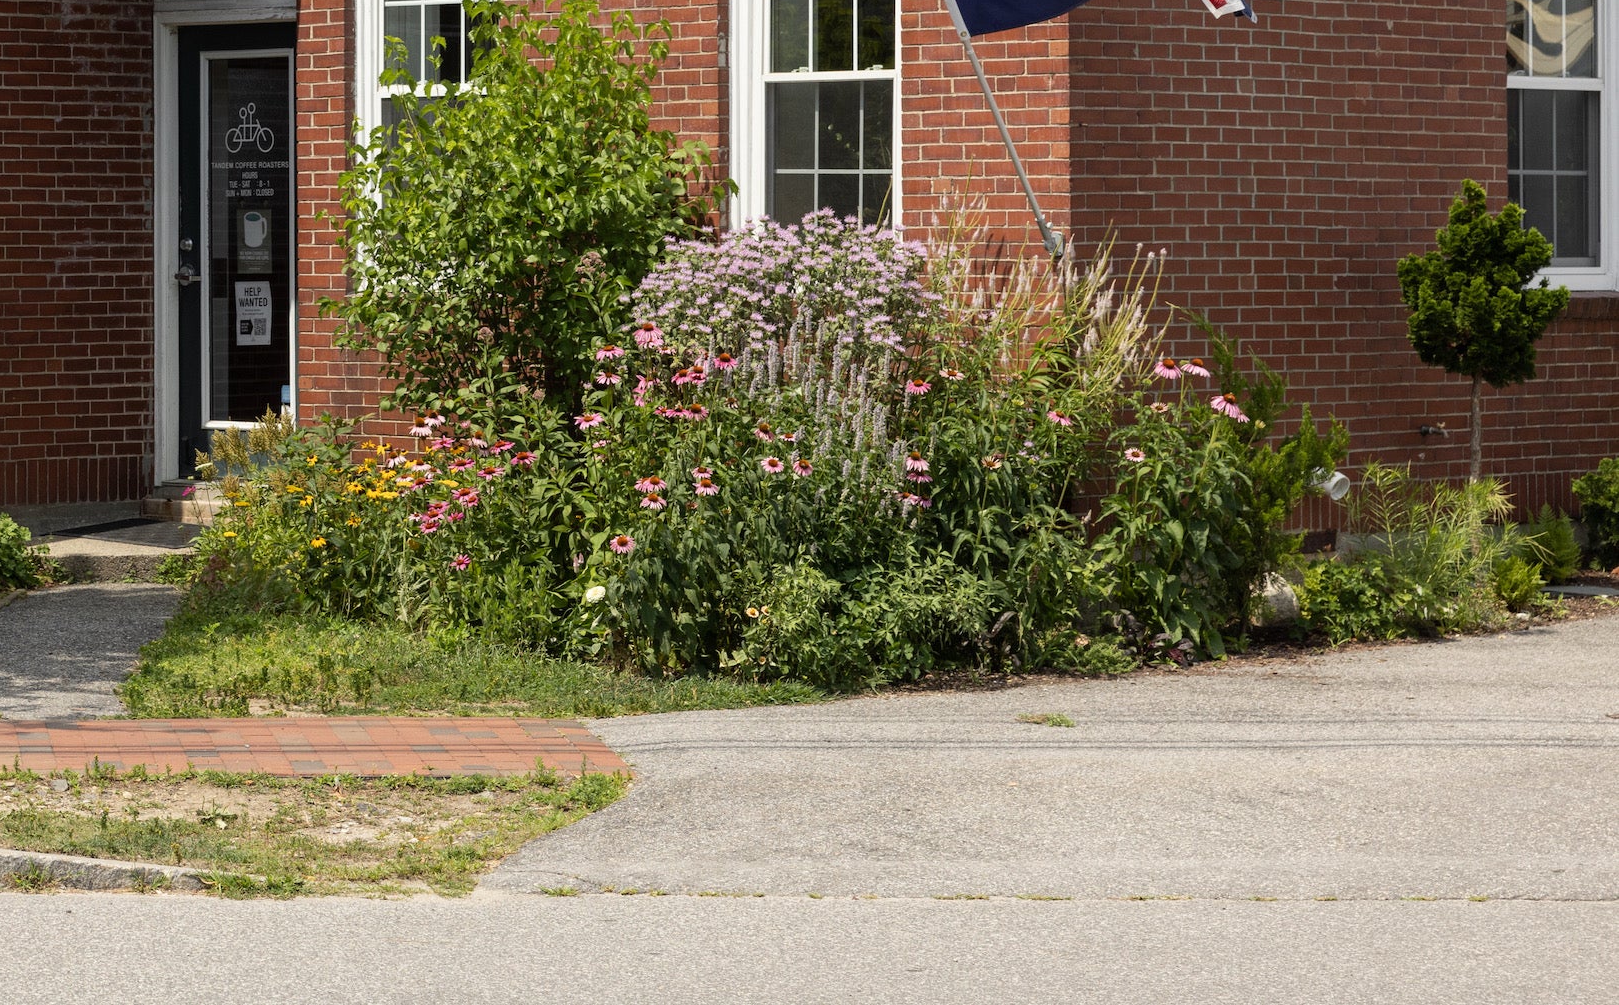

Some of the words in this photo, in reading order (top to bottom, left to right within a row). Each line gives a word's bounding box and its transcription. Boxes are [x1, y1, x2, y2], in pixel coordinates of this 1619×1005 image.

[258, 161, 289, 169] ROASTERS
[242, 171, 258, 179] HOURS
[241, 180, 251, 188] SAT
[255, 188, 274, 196] CLOSED
[244, 287, 262, 297] HELP
[238, 297, 268, 308] WANTED
